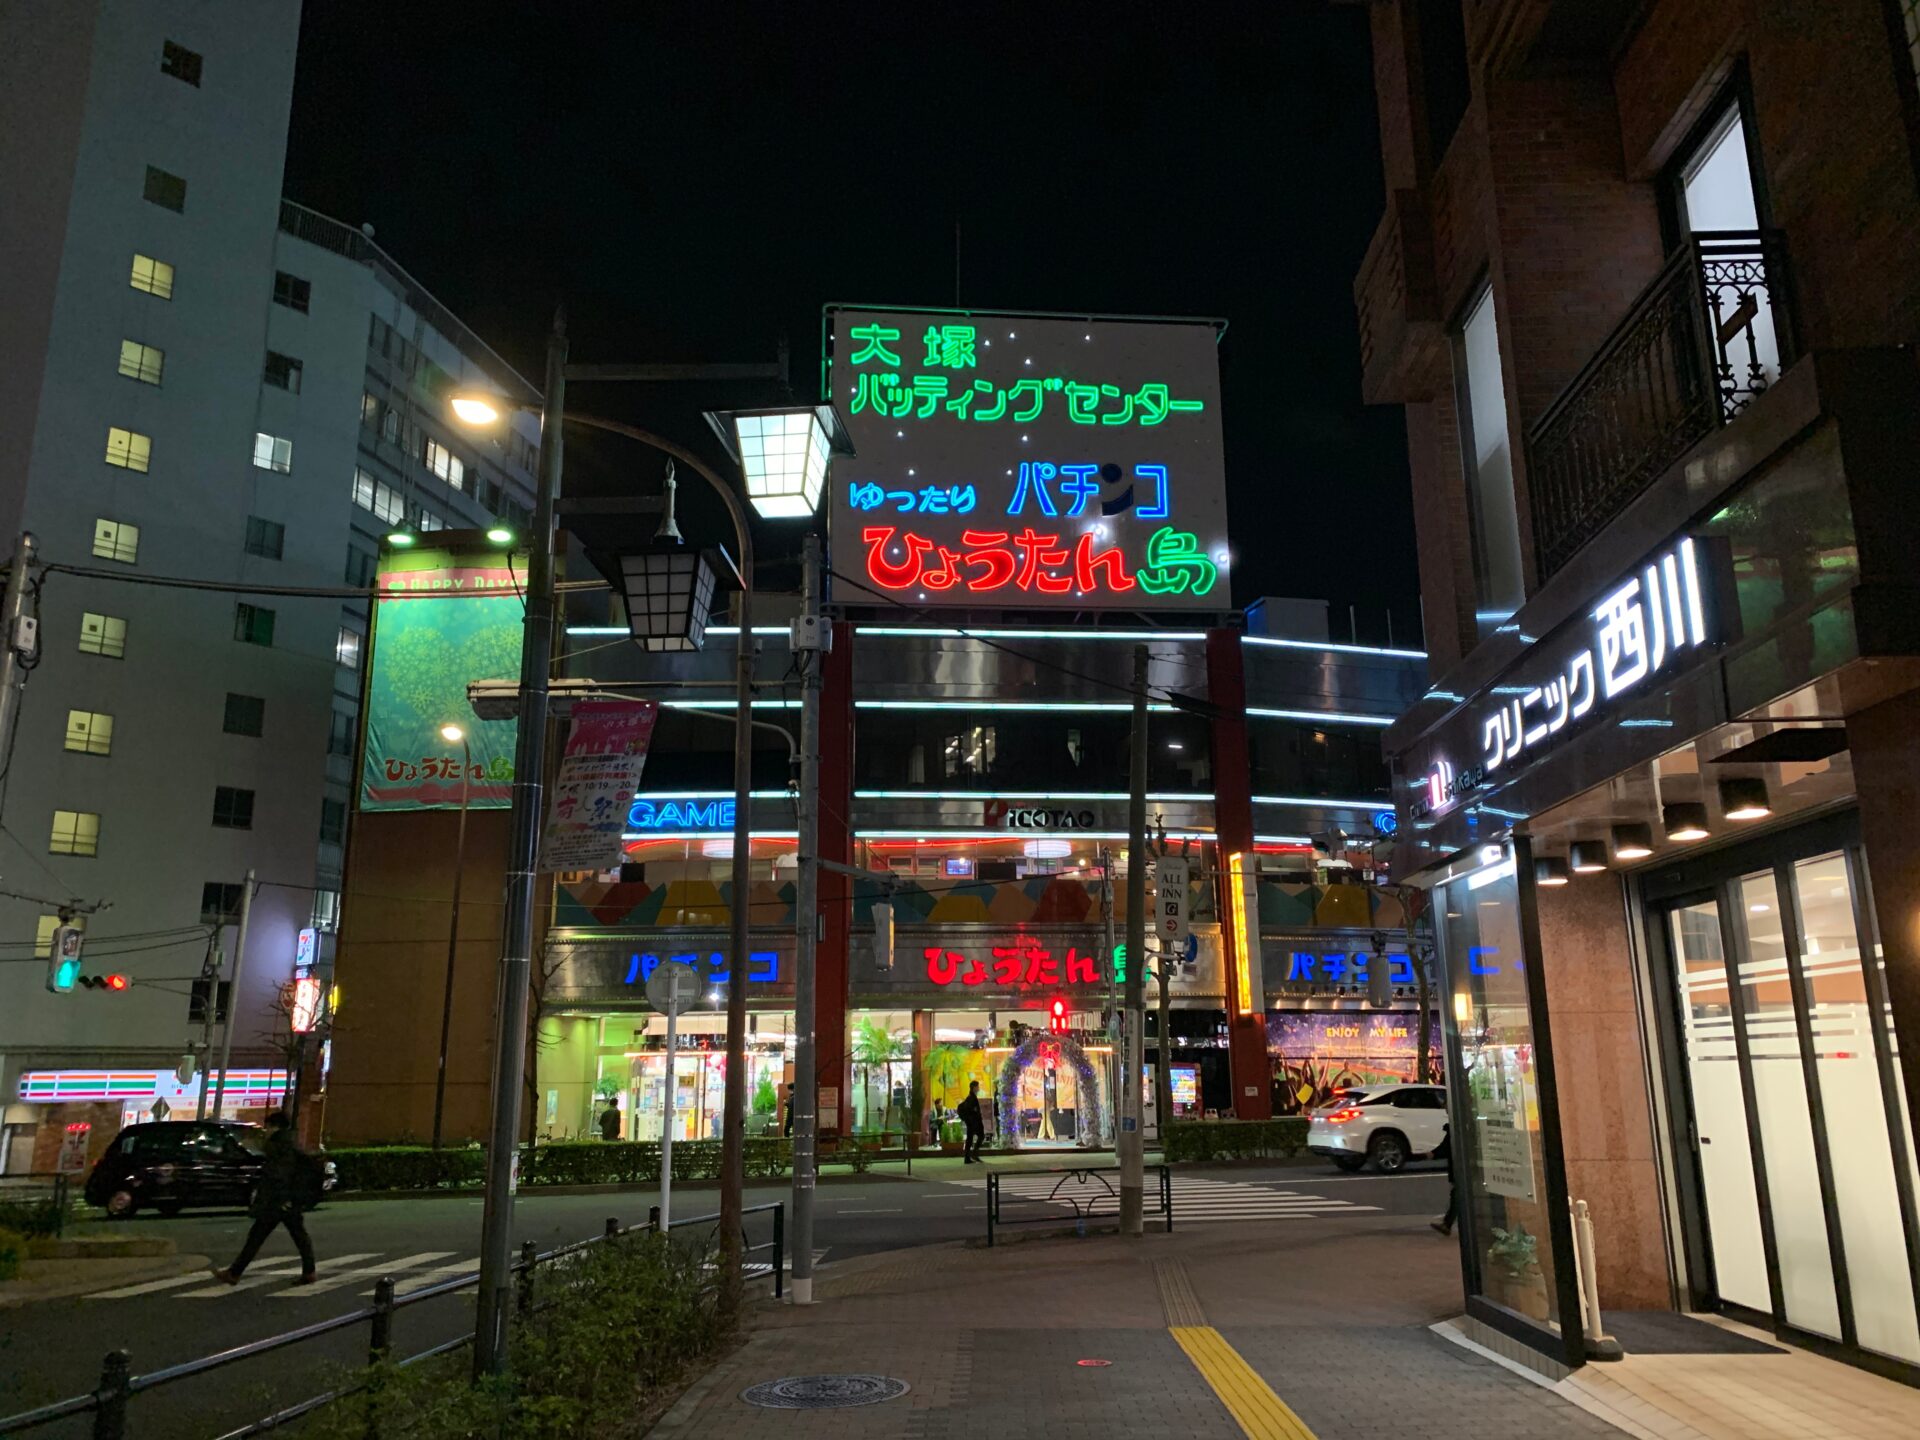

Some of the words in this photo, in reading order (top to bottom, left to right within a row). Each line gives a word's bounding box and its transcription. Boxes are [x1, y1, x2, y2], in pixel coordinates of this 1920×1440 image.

[850, 323, 976, 368] 大塚
[850, 373, 1203, 425] バッティングセンター
[850, 482, 977, 513] ゆったり
[1007, 461, 1169, 518] パチンコ
[862, 526, 1218, 595] ひょうたん島
[1162, 873, 1182, 885] ALL
[1162, 888, 1182, 899] INN
[1326, 1026, 1360, 1038] ENJOY
[1369, 1027, 1386, 1038] MY
[1389, 1027, 1407, 1038] LIFE
